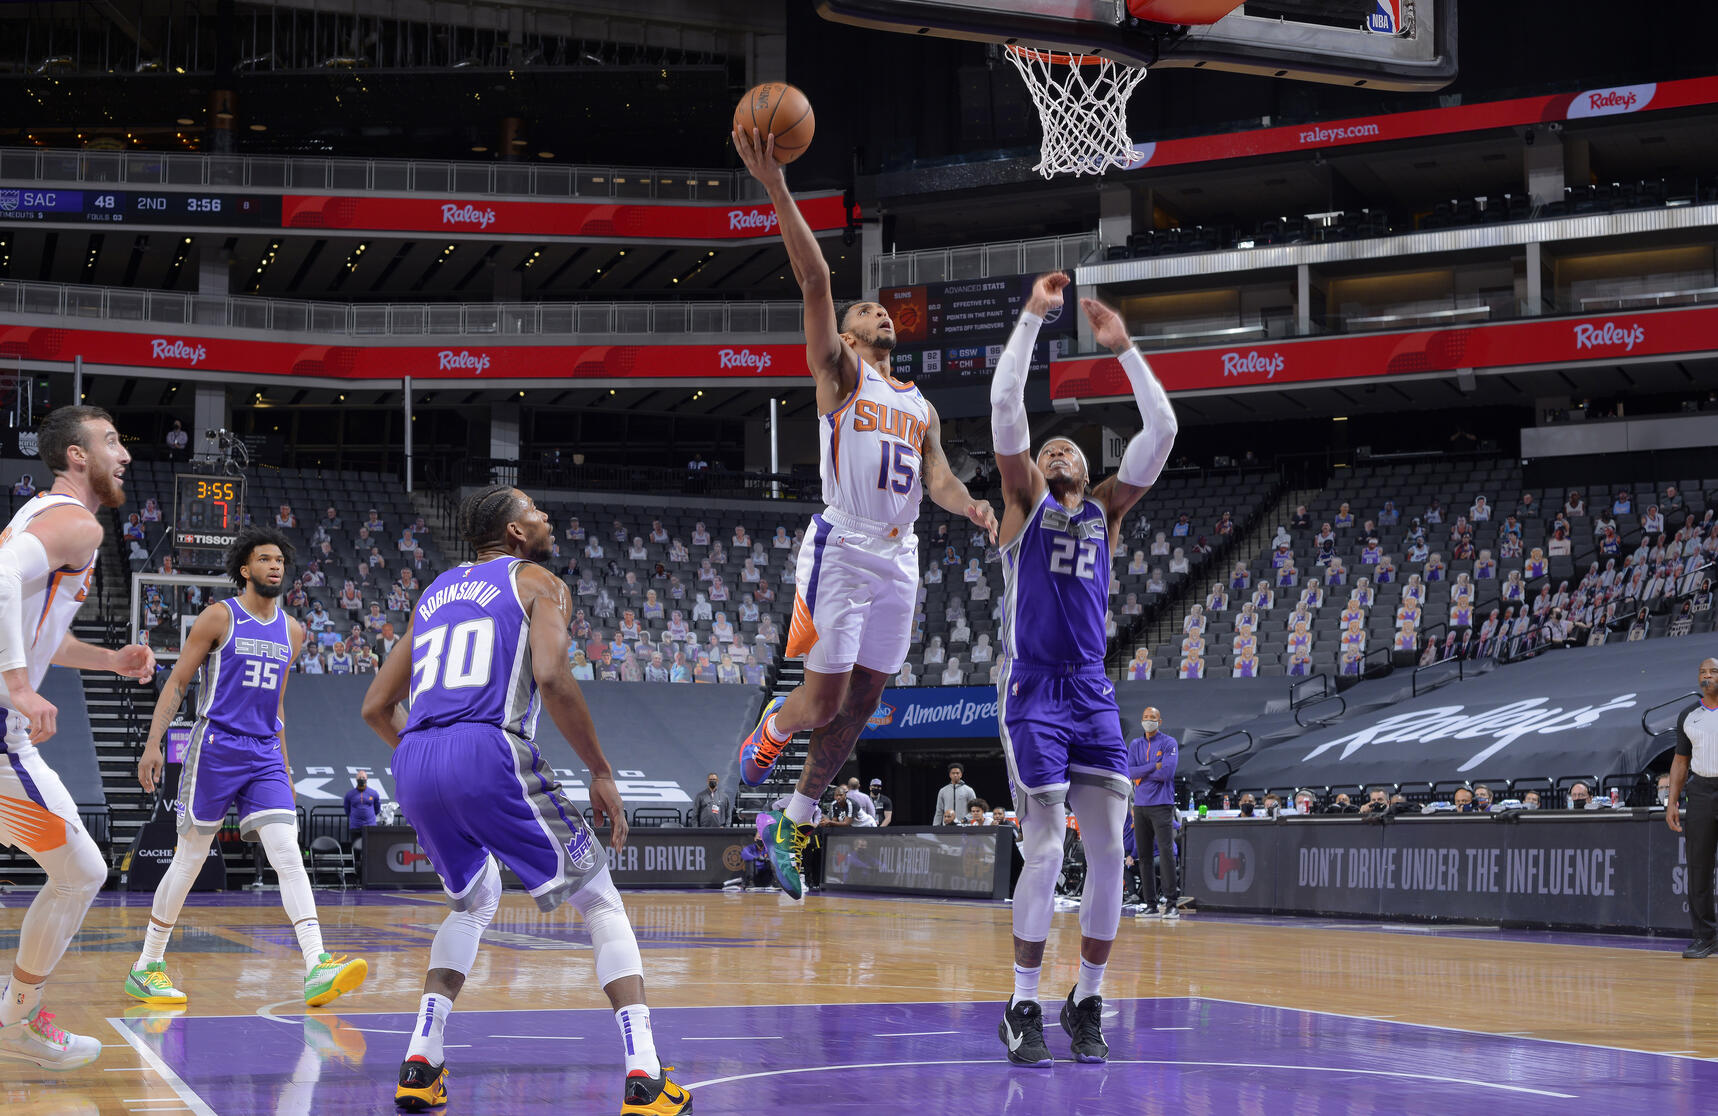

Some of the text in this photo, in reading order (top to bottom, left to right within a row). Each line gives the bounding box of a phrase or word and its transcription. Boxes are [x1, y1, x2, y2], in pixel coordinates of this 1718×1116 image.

[1372, 13, 1389, 29] NBA
[1588, 90, 1637, 111] Raley's
[1299, 122, 1379, 143] raleys.com
[24, 192, 56, 206] SAC
[94, 195, 115, 208] 48
[137, 197, 167, 210] 2ND
[187, 198, 222, 211] 3:56
[441, 203, 495, 229] Raley's
[728, 209, 778, 233] Raley's
[944, 281, 1005, 294] ADVANCED STATS
[1573, 322, 1645, 351] Raley's
[151, 338, 206, 365] Raley's
[438, 350, 490, 374] Raley's
[718, 349, 772, 373] Raley's
[959, 348, 978, 357] GSW
[959, 360, 973, 368] CHI
[1221, 350, 1285, 378] Raley's
[853, 399, 926, 455] SUNS
[877, 439, 915, 496] 15
[197, 481, 234, 500] 3:55
[213, 501, 228, 529] 7
[194, 534, 237, 545] TISSOT
[1050, 536, 1097, 579] 22
[418, 580, 501, 622] ROBINSON III
[235, 636, 289, 662] SAC
[411, 616, 495, 705] 30
[242, 659, 280, 690] 35
[899, 699, 999, 728] Almond Bree
[139, 849, 173, 857] CACHE
[645, 845, 706, 872] DRIVER
[879, 846, 895, 873] CALL
[902, 847, 930, 874] FRIEND
[1299, 847, 1616, 897] DON'T DRIVE UNDER THE INFLUENCE
